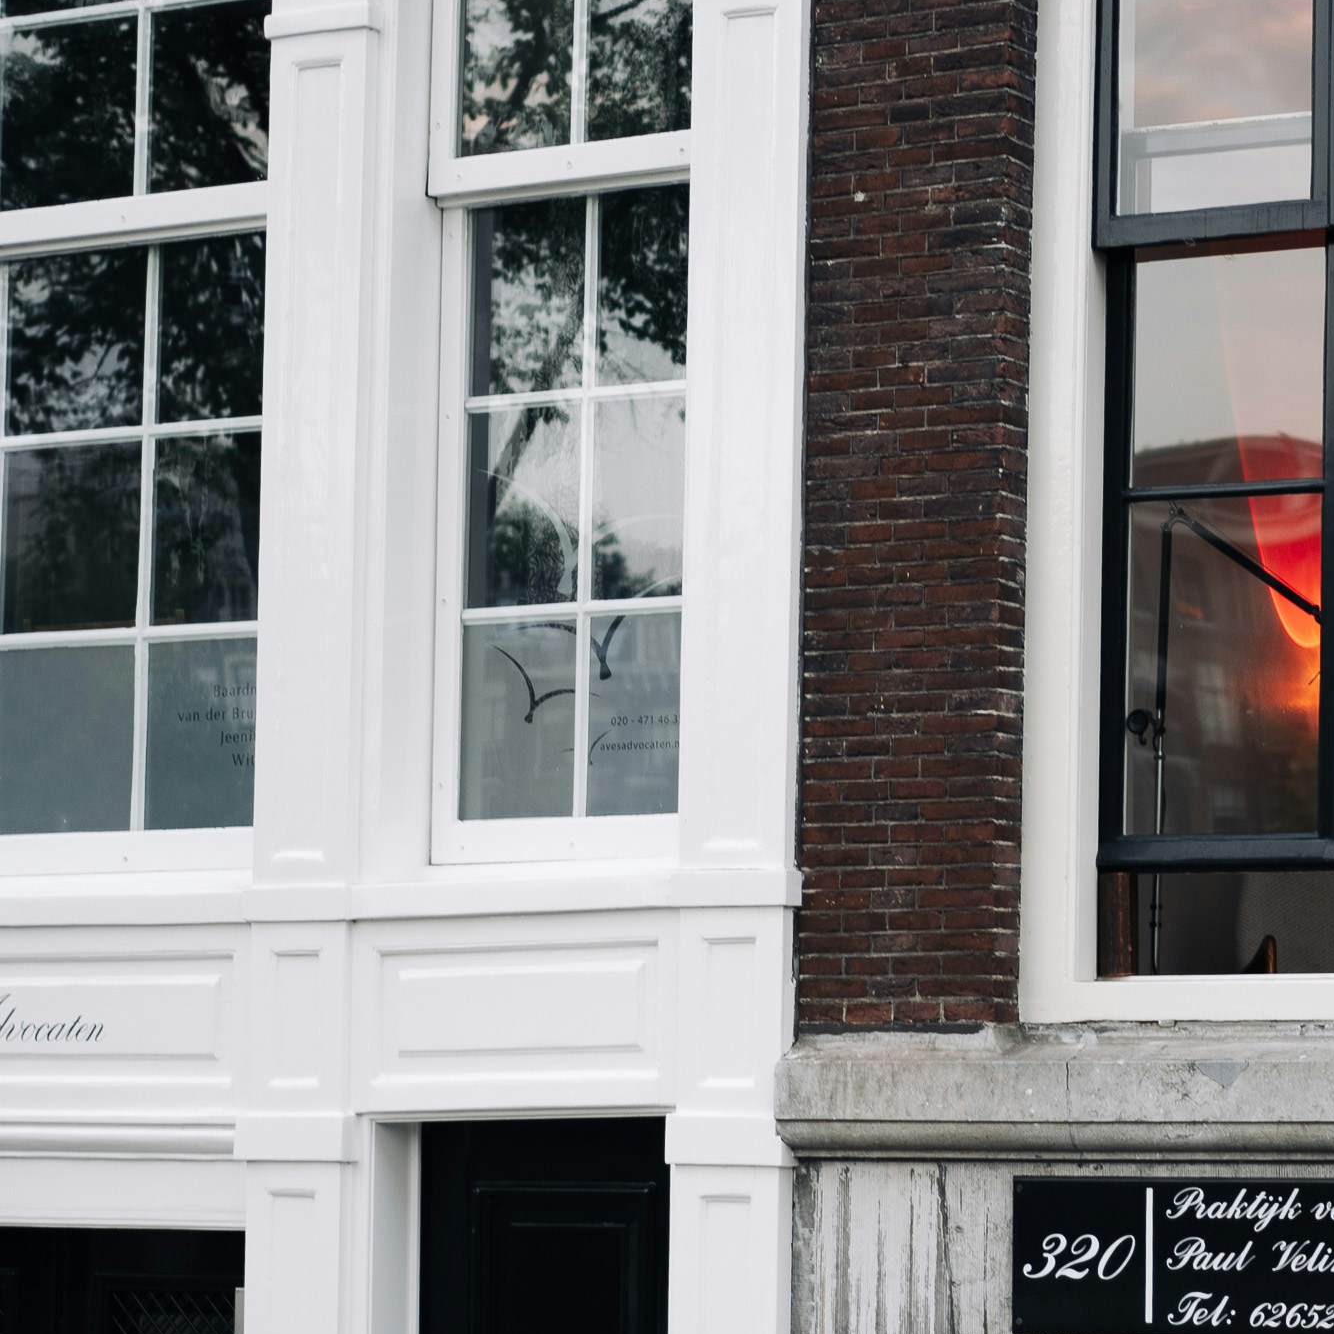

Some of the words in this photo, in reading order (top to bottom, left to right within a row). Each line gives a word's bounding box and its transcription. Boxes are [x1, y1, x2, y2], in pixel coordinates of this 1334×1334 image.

[177, 711, 200, 723] van
[205, 707, 226, 721] der
[610, 715, 629, 726] 020
[637, 715, 654, 726] 471
[658, 714, 670, 725] 46
[220, 729, 256, 746] Jeeni
[0, 993, 105, 1042] vocaten
[1165, 1186, 1302, 1233] Praktijk
[1022, 1232, 1136, 1281] 320
[1165, 1236, 1256, 1272] Paul
[1166, 1291, 1237, 1327] Tel:
